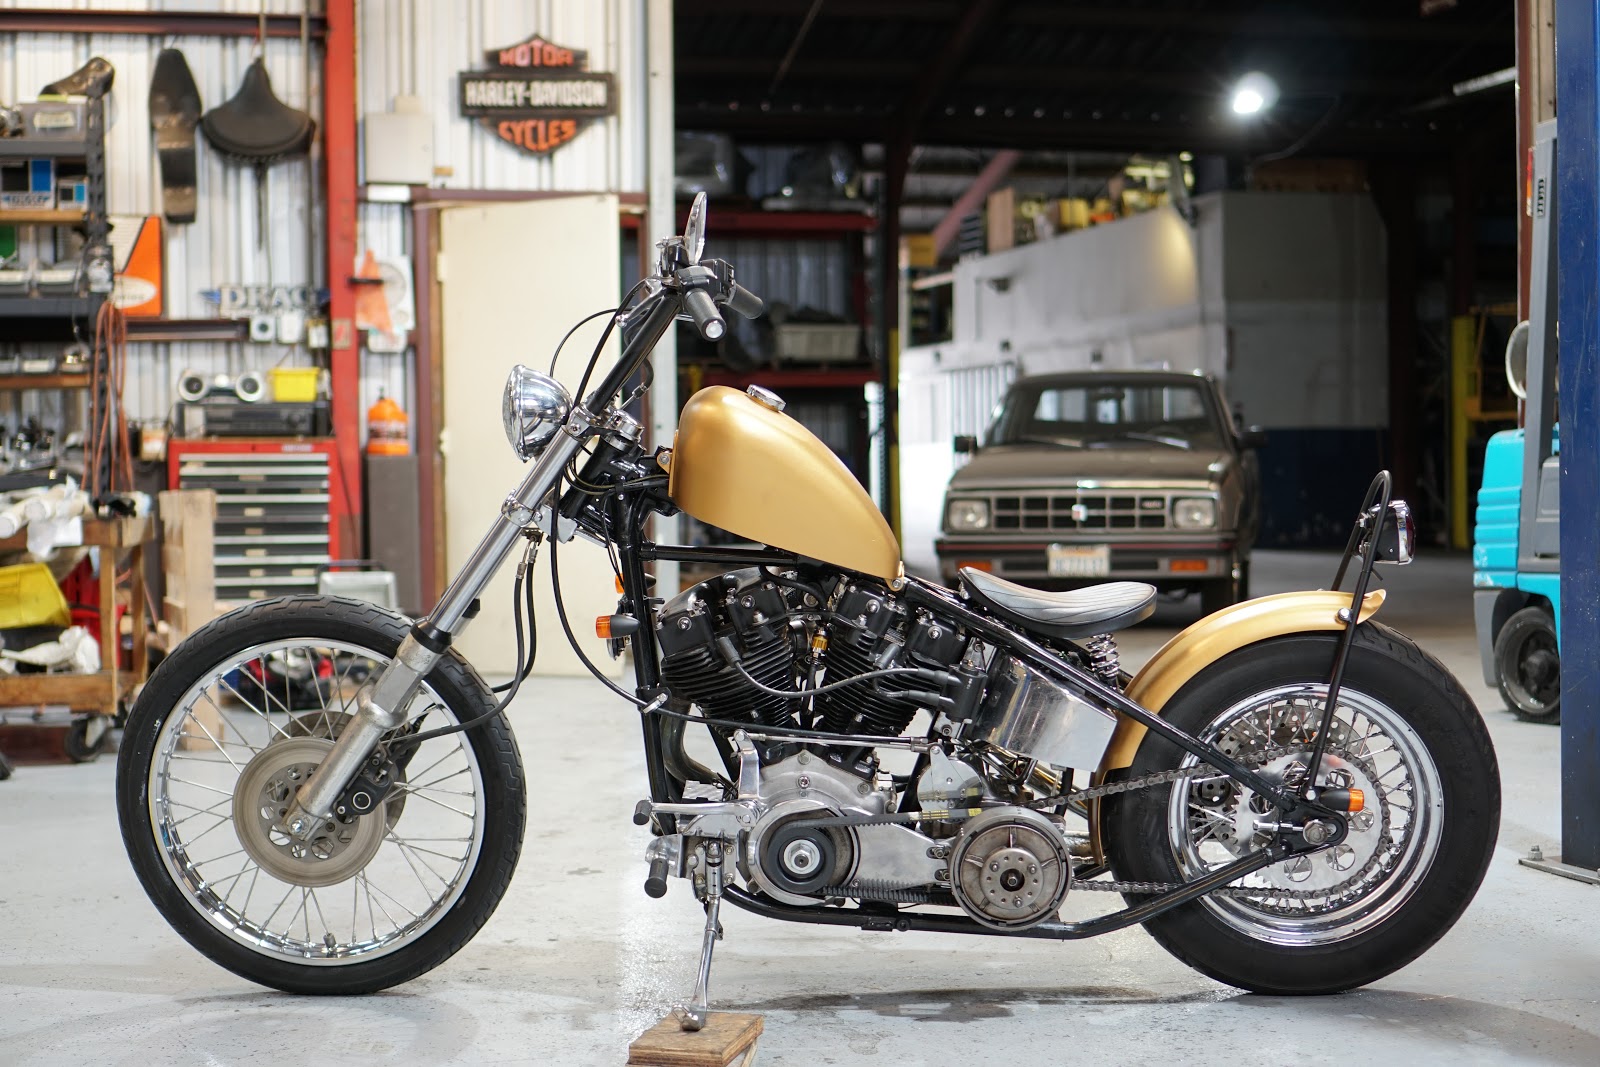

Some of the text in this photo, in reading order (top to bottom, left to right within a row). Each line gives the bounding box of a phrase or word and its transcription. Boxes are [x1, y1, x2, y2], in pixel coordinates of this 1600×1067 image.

[499, 39, 574, 67] MOTOR
[465, 80, 607, 107] HARLEY-DAVIDSON
[498, 119, 577, 152] CYCLES
